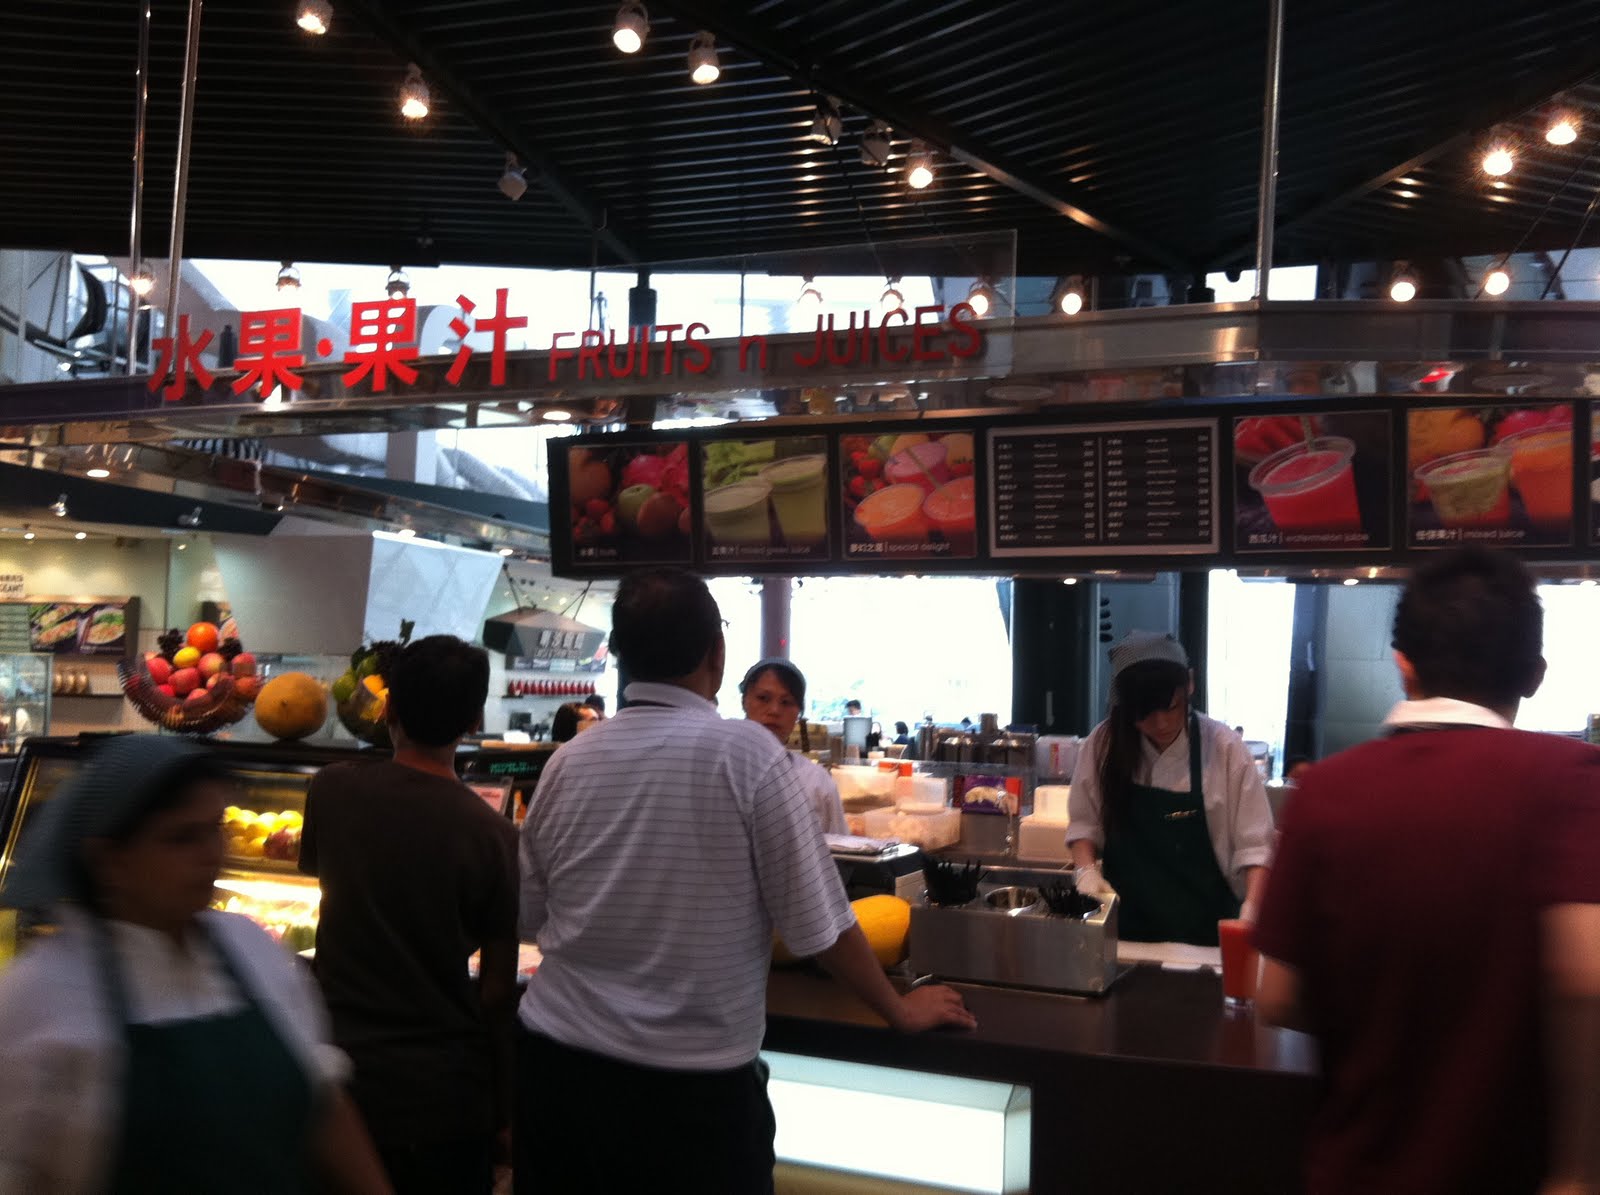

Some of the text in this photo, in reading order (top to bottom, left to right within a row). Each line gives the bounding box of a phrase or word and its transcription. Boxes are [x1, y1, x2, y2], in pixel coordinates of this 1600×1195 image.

[547, 322, 712, 382] FRUITS
[794, 302, 984, 367] JUICES
[888, 543, 918, 553] special
